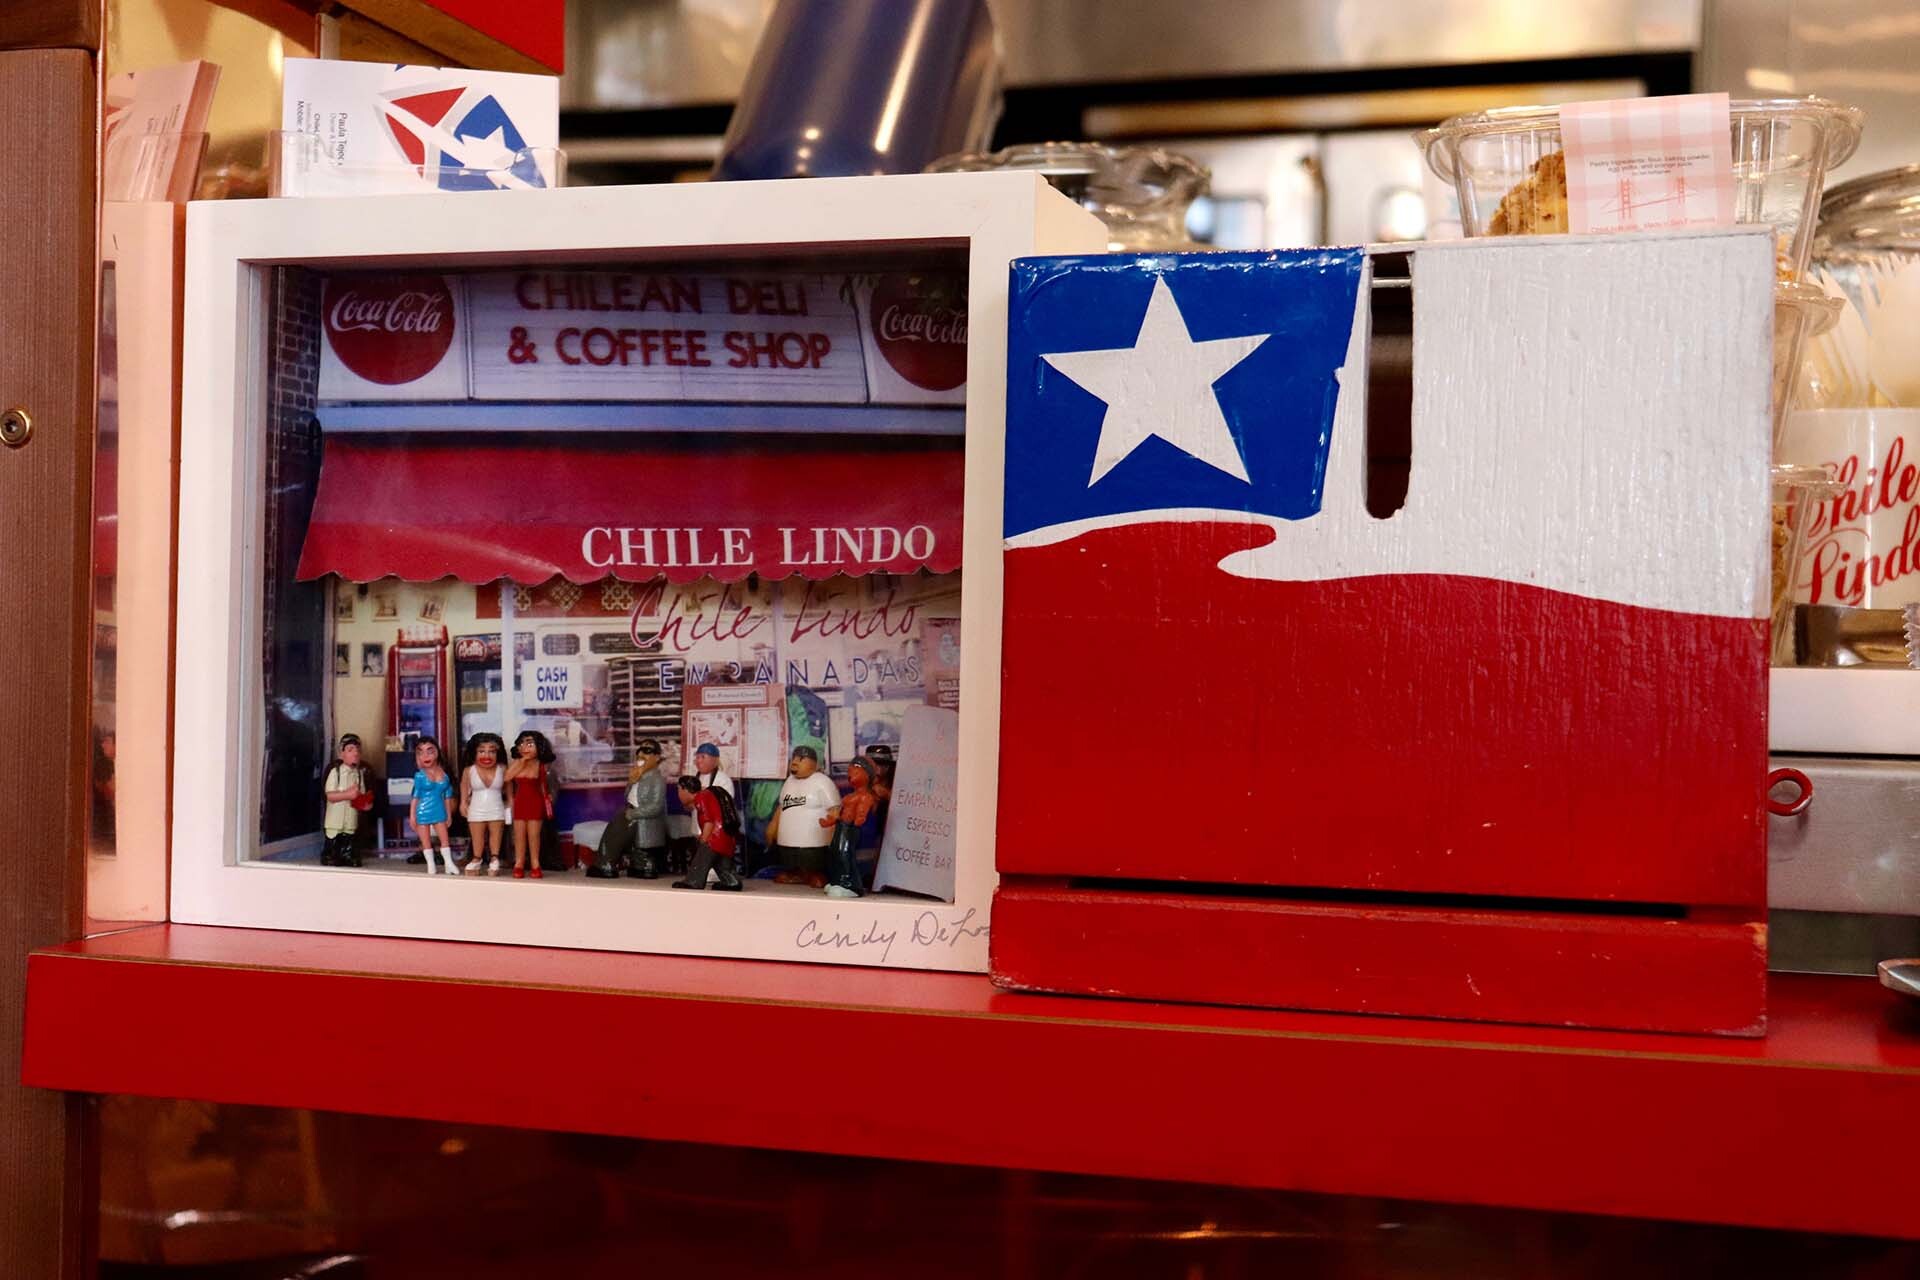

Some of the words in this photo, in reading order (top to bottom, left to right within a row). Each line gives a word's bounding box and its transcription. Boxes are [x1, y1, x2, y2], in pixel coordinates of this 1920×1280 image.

[330, 290, 445, 333] Coca-Cola
[514, 273, 704, 315] CHILEAN
[725, 278, 809, 317] DELI
[507, 326, 538, 364] &
[555, 327, 711, 367] COFFEE
[723, 331, 832, 370] SHOP
[581, 526, 754, 568] CHILE
[778, 524, 936, 566] LINDO
[630, 577, 768, 652] Chile
[789, 580, 925, 644] Lindo
[536, 666, 568, 683] CASH
[536, 685, 568, 702] ONLY
[657, 654, 921, 692] EMPANADAS
[905, 815, 952, 838] ESPRESSO
[895, 847, 932, 867] COFFEE
[796, 913, 898, 963] Cindy
